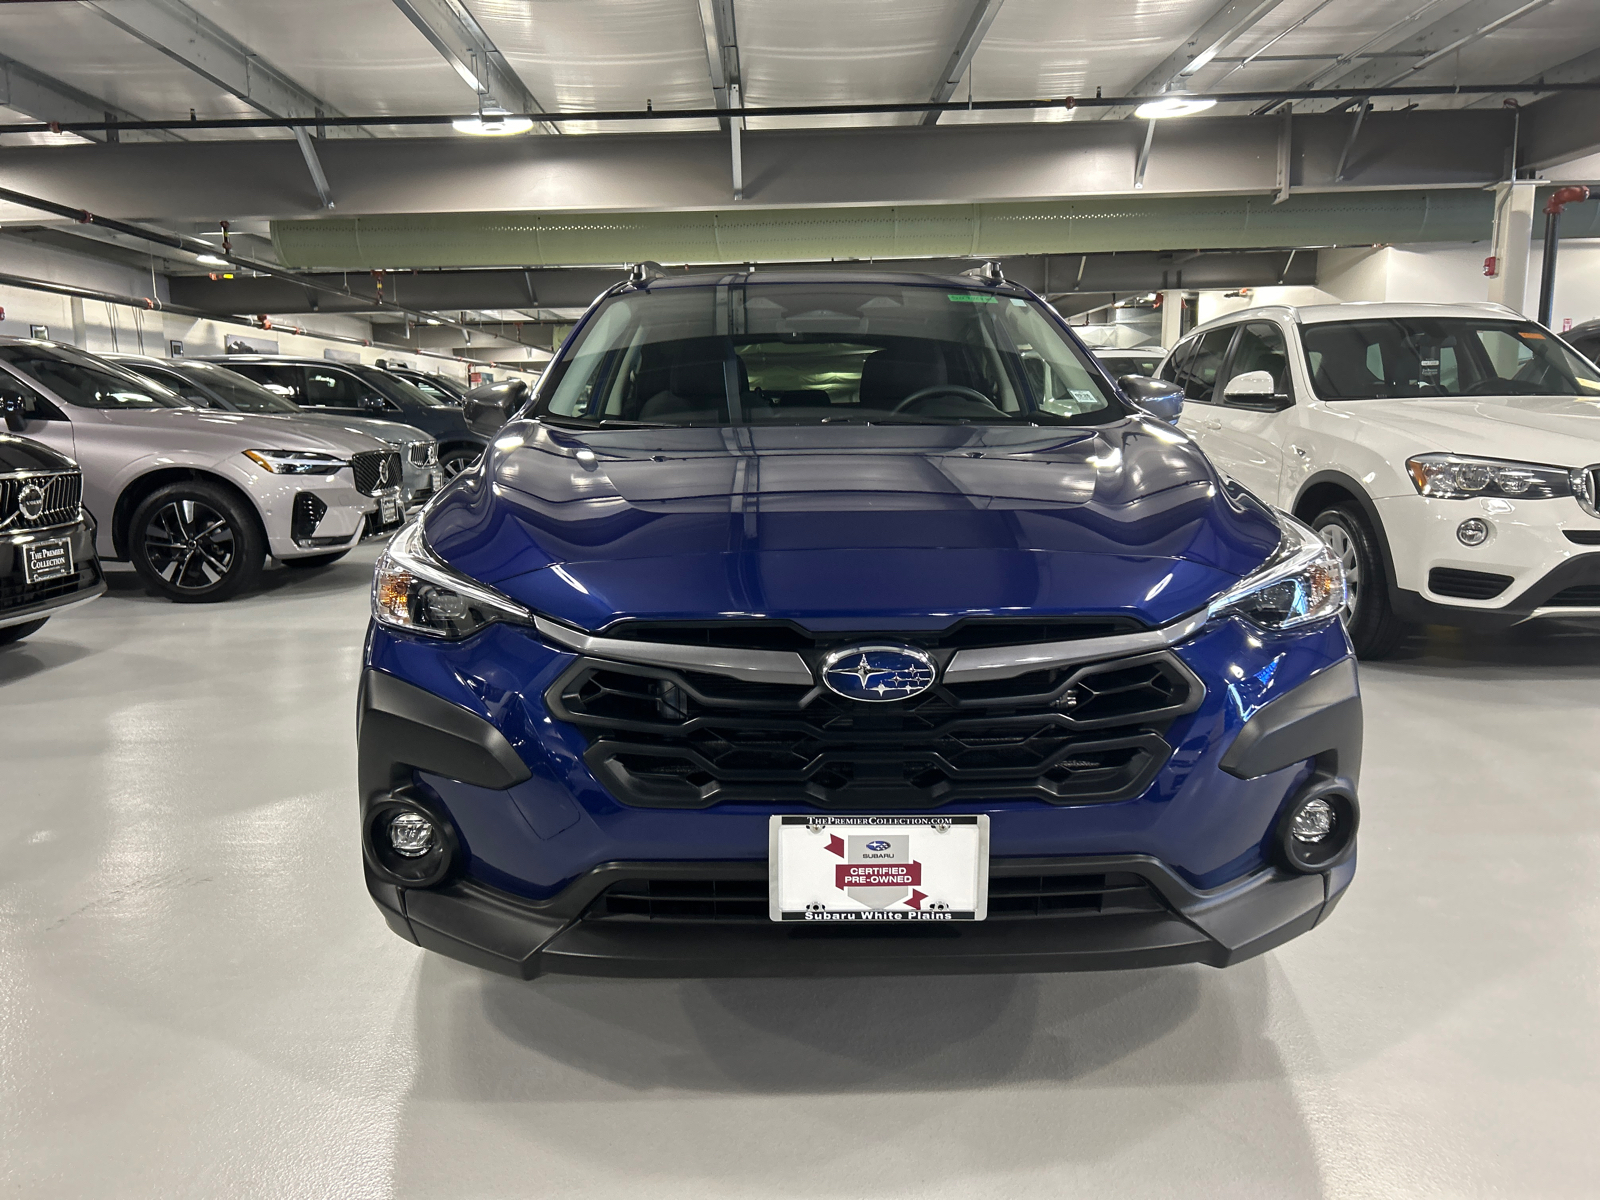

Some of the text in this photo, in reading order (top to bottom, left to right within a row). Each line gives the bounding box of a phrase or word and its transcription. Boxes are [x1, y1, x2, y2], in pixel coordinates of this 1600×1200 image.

[31, 557, 66, 570] COLLECTION
[850, 867, 907, 875] CERTIFIED
[844, 875, 912, 884] PRE-OWNED
[804, 911, 952, 920] Subaru White Plains
